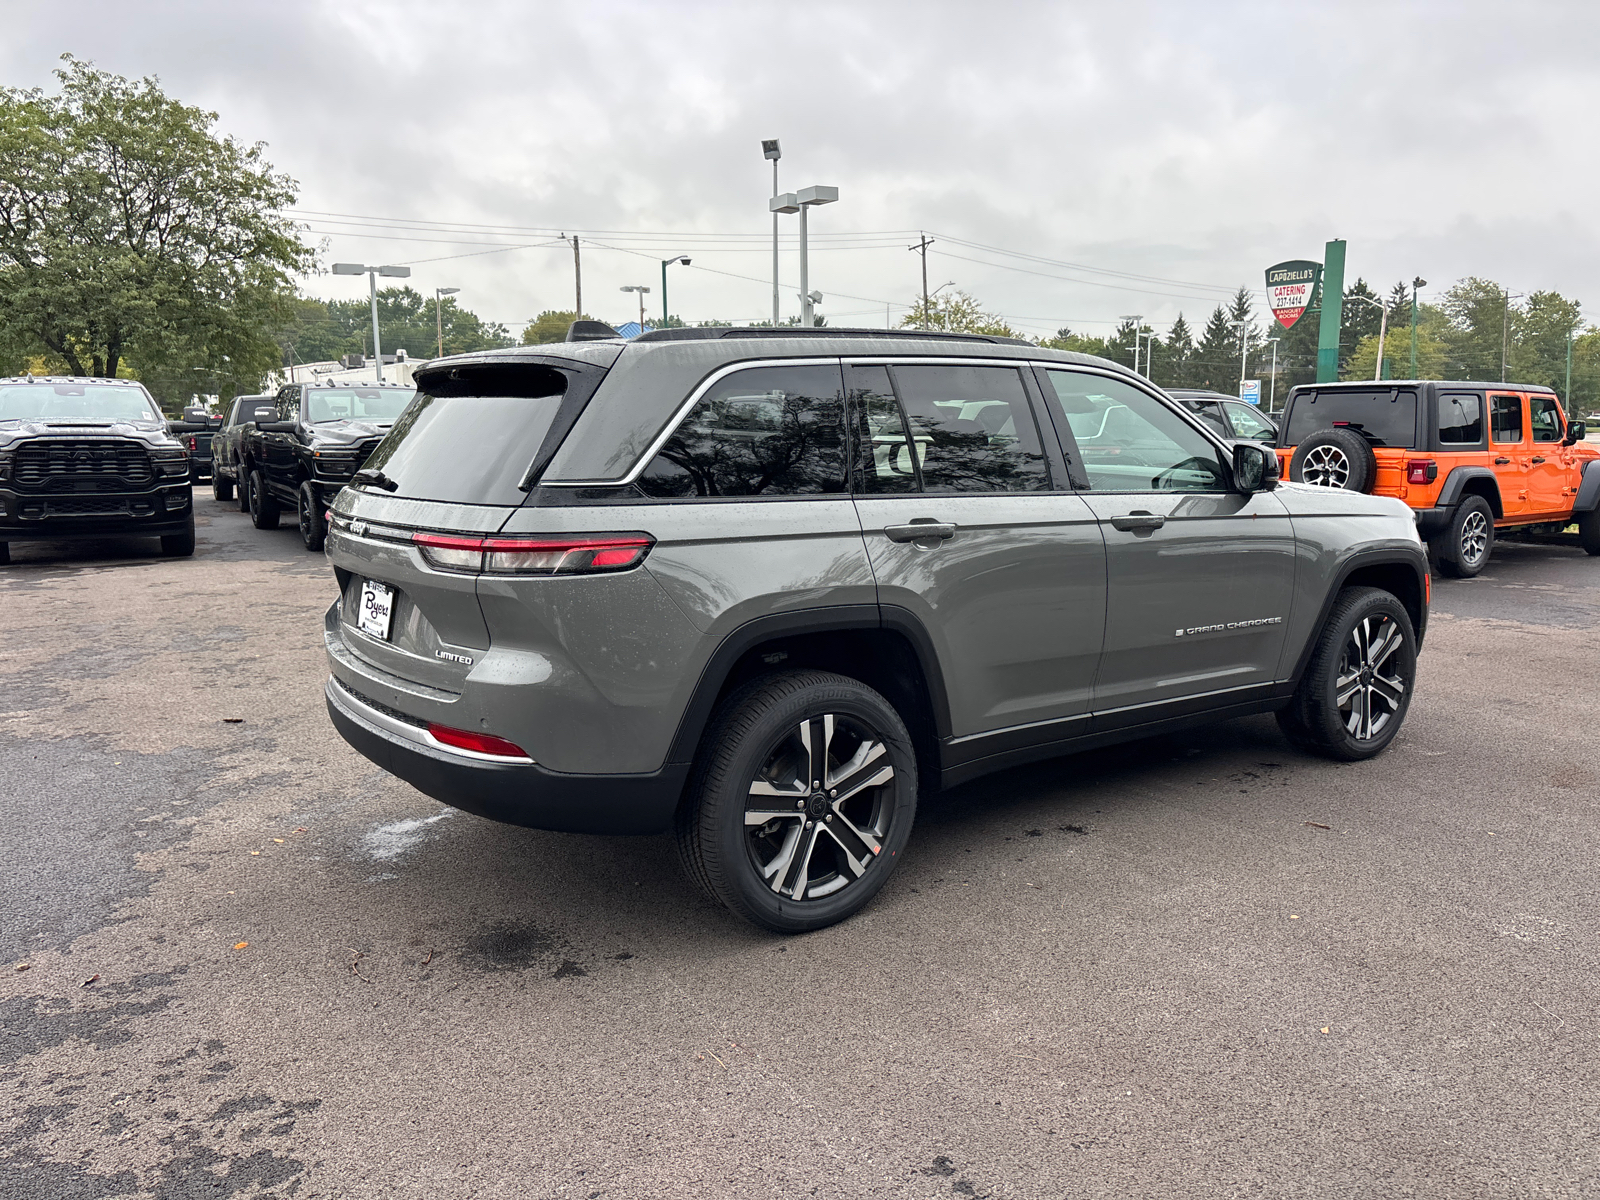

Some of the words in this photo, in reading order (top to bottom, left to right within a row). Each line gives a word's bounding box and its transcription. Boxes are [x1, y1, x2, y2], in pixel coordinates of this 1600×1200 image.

[1269, 269, 1313, 283] CAPOZIELLO'S
[1274, 285, 1306, 297] CATERING
[1276, 296, 1302, 307] 237-1414
[350, 517, 368, 536] Jeep
[1186, 623, 1225, 635] GRAND
[1227, 616, 1282, 630] CHEROKEE
[435, 649, 473, 665] LIMITED
